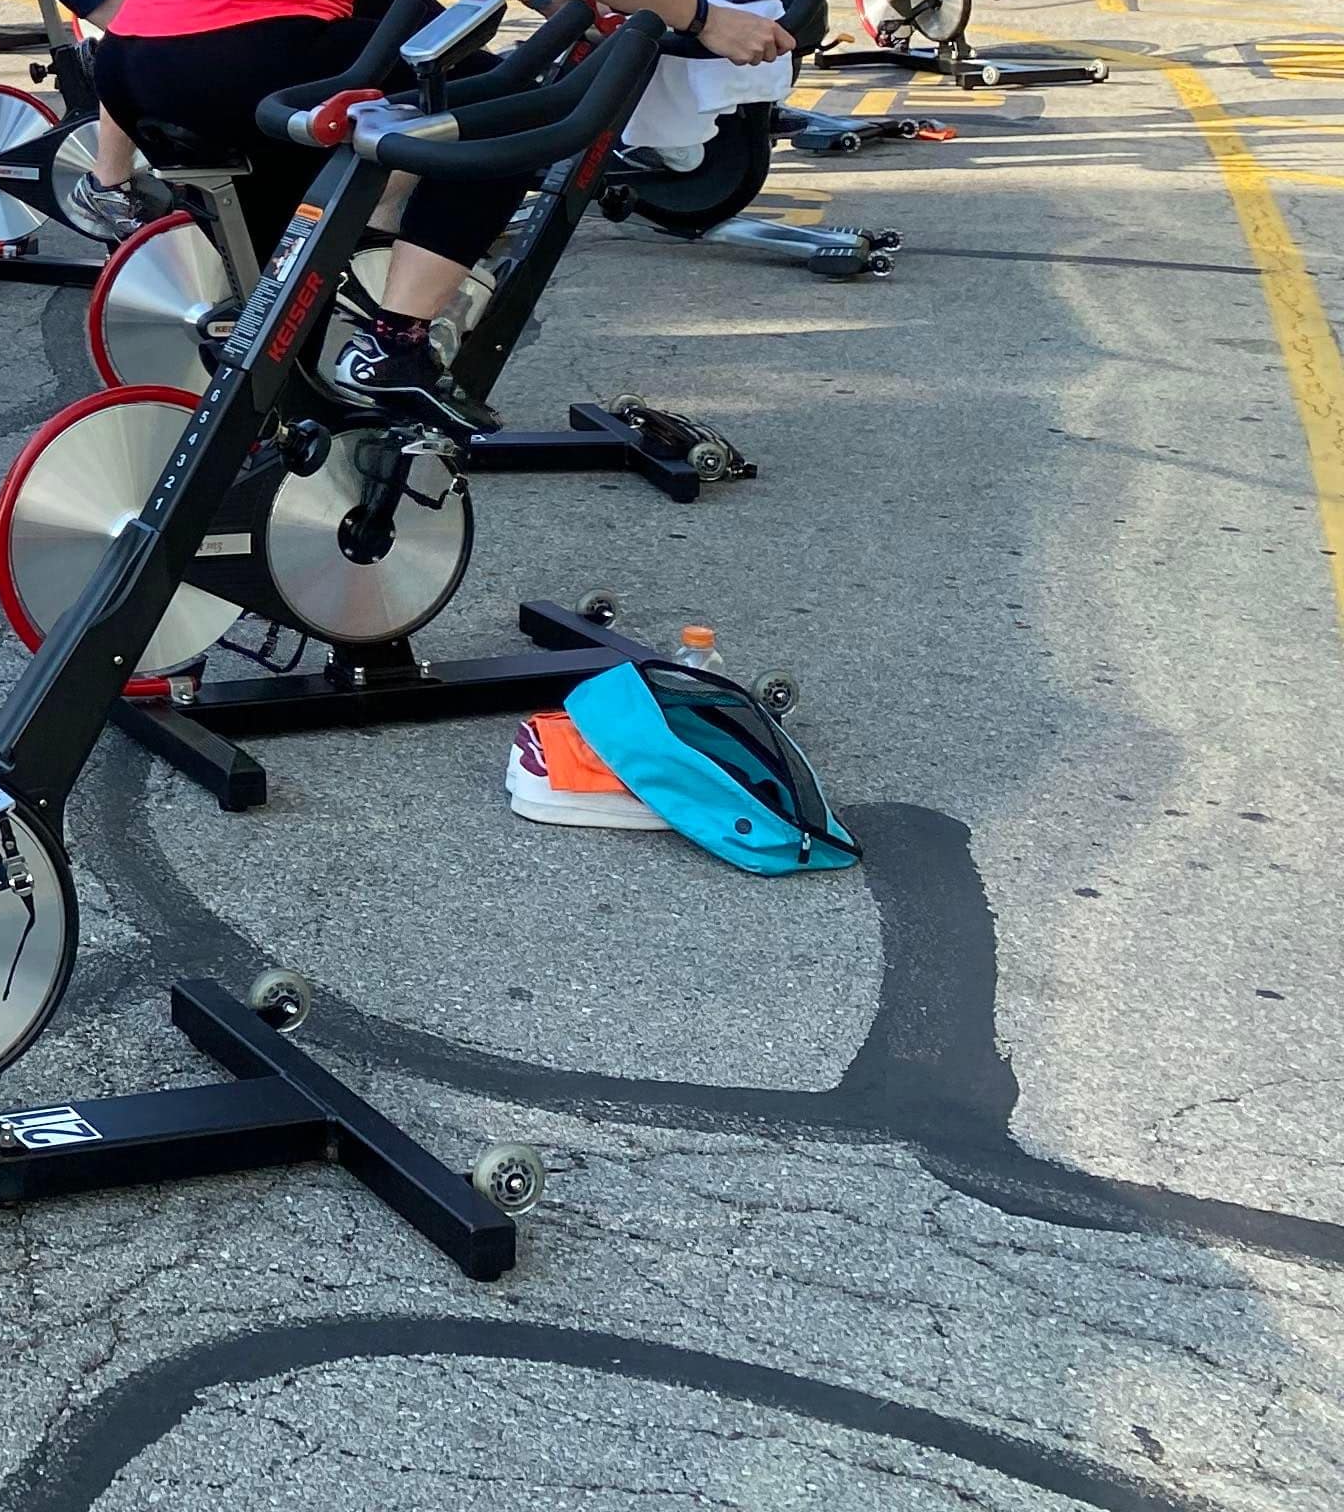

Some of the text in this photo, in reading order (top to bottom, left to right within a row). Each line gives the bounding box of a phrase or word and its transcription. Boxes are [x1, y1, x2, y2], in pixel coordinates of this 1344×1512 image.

[268, 271, 324, 364] KEISER
[221, 367, 232, 380] 7
[210, 389, 221, 403] 6
[199, 410, 210, 424] 5
[188, 432, 199, 446] 4
[176, 453, 187, 467] 3
[164, 475, 175, 489] 2
[155, 497, 163, 511] 1
